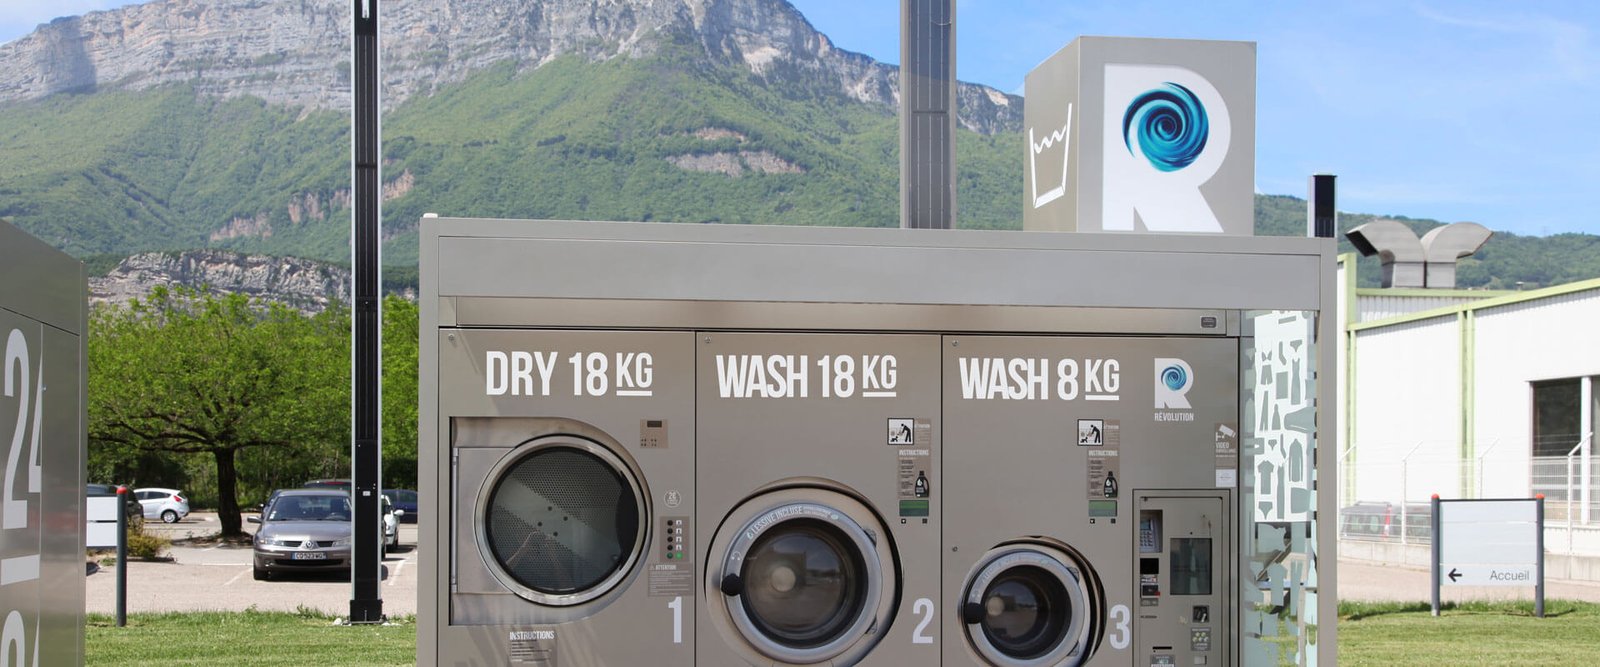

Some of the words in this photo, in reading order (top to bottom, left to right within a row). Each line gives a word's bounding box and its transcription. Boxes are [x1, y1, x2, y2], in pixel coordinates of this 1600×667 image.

[486, 351, 558, 396] DRY
[569, 352, 608, 396] 18
[616, 352, 653, 389] KG
[715, 355, 808, 398] WASH
[817, 355, 855, 398] 18
[862, 355, 898, 389] KG
[958, 357, 1048, 400] WASH
[1057, 358, 1079, 401] 8
[1085, 359, 1120, 394] KG
[1154, 411, 1194, 421] RÉVOLUTION
[751, 513, 777, 535] LESSIVE
[775, 505, 804, 519] INCLUSE
[1490, 570, 1530, 581] Accueil
[510, 630, 555, 640] INSTRUCTIONS
[668, 596, 682, 643] 1
[912, 597, 935, 644] 2
[1109, 604, 1131, 650] 3
